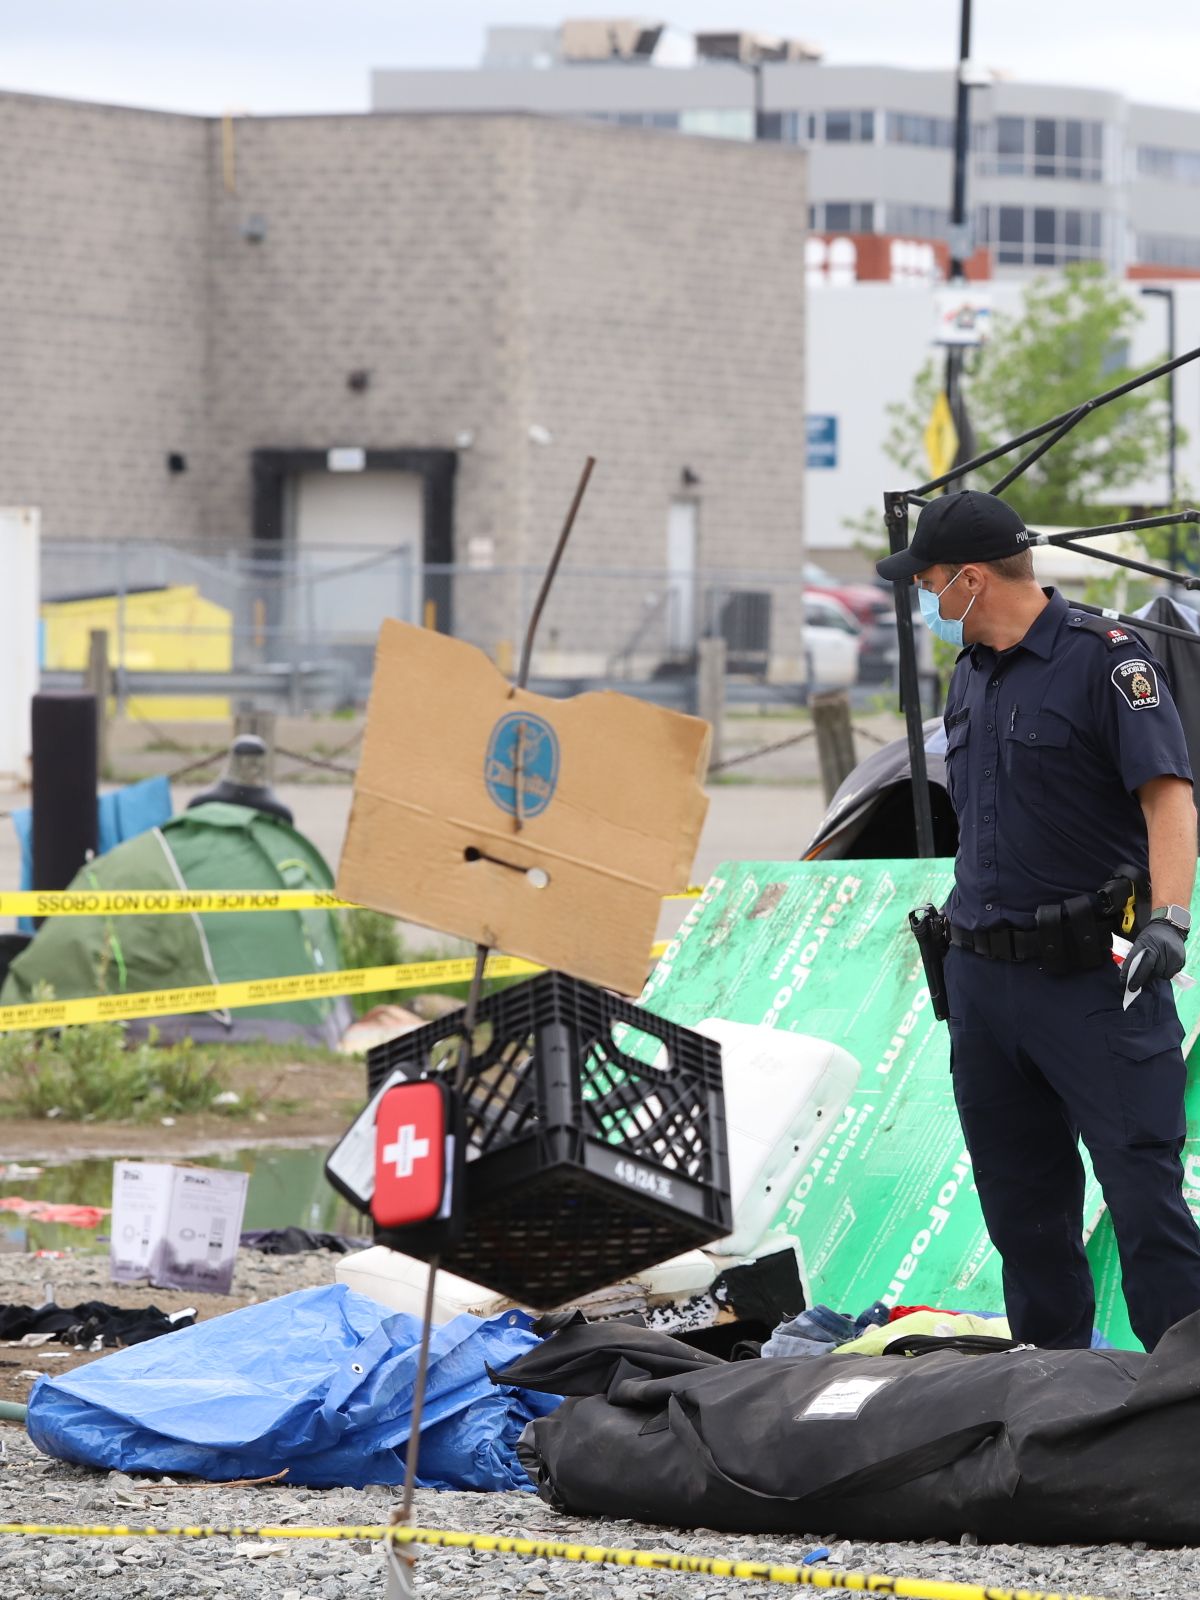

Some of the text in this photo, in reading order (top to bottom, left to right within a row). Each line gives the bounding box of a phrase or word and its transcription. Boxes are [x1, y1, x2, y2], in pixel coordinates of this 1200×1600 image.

[1121, 666, 1148, 676] SUDBURY
[1132, 696, 1157, 707] POLICE
[38, 894, 279, 912] POLICE LINE DO NOT CROSS
[769, 876, 837, 980] Insulation
[825, 1104, 875, 1184] Isolant
